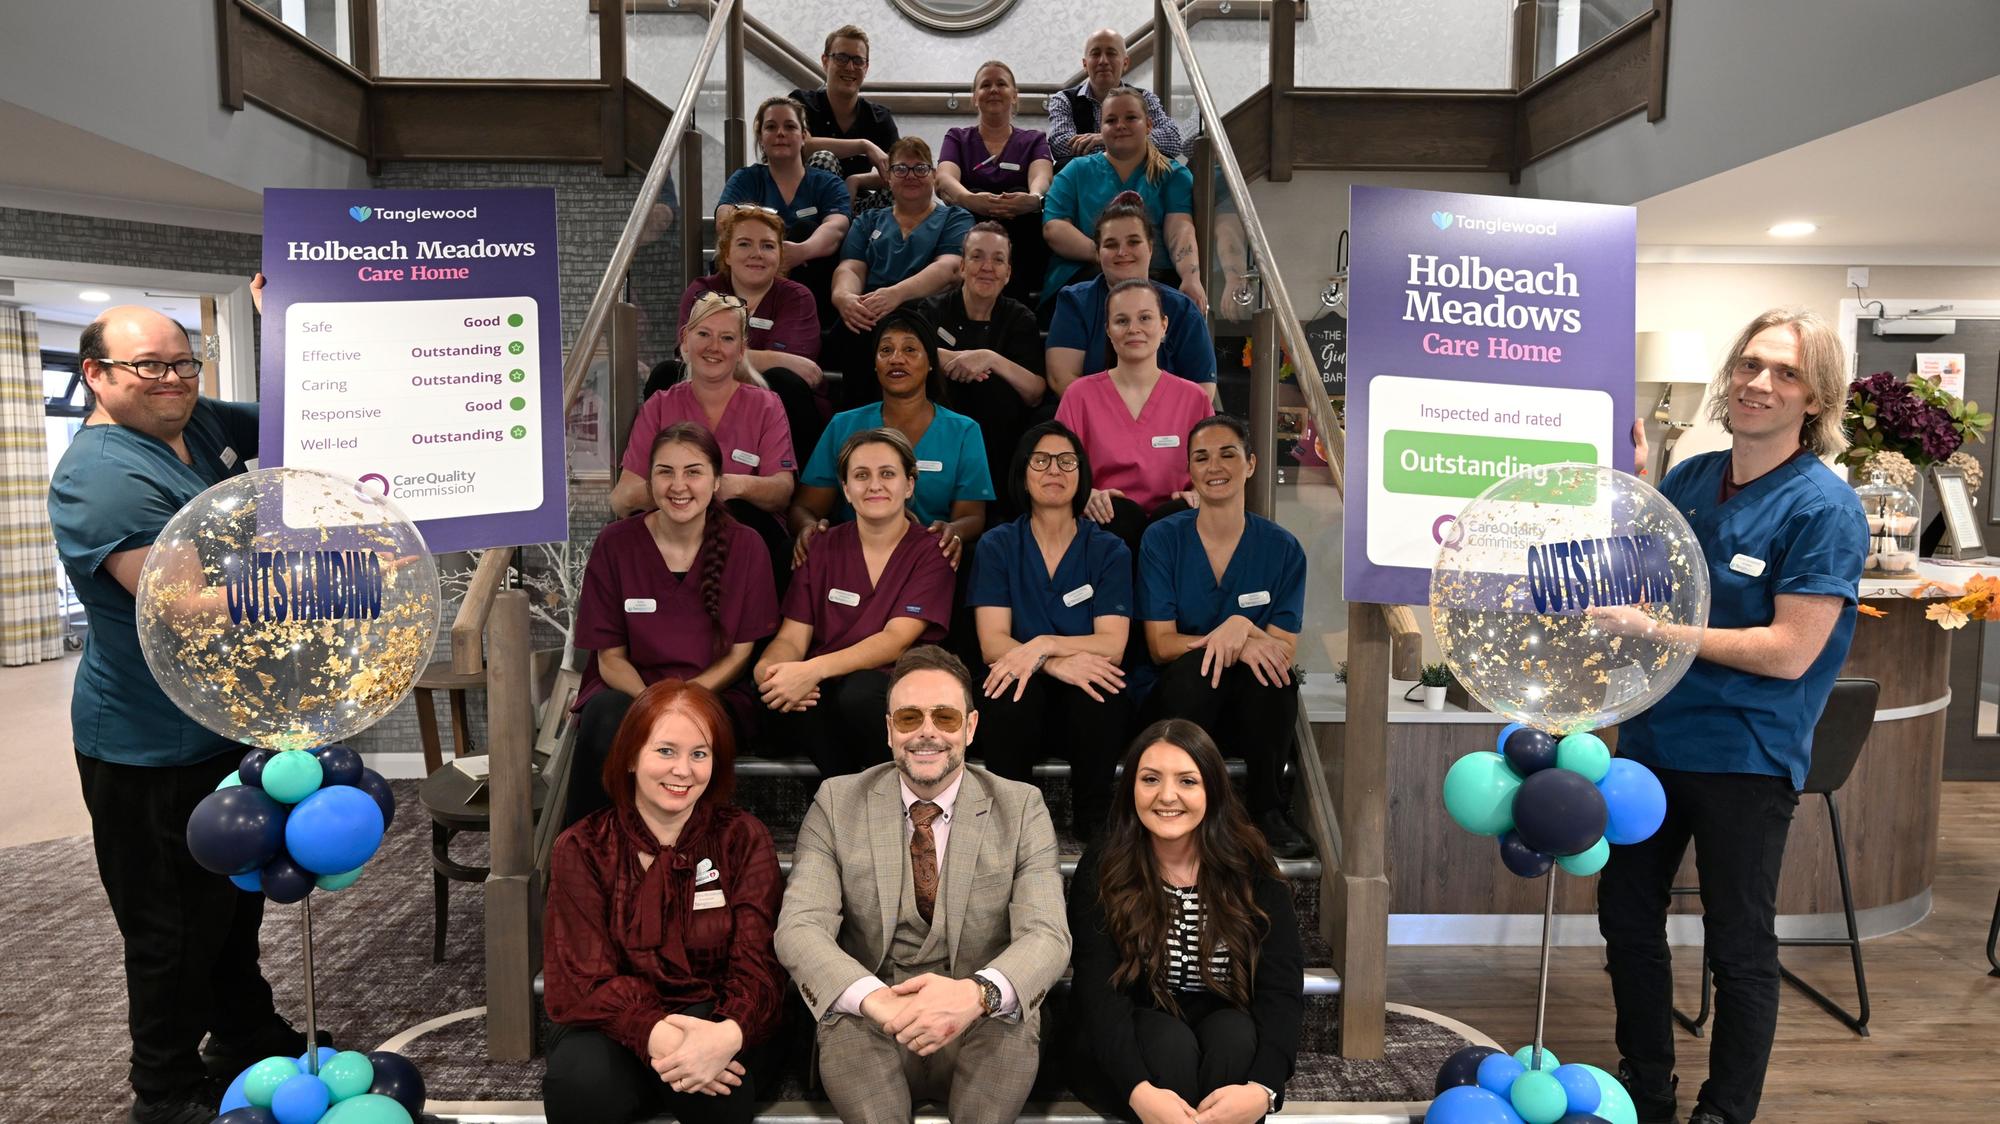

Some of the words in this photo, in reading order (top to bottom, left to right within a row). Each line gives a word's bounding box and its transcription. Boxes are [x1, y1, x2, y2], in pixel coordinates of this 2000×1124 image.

[374, 207, 477, 222] Tanglewood
[1455, 214, 1557, 236] Tanglewood
[288, 241, 408, 262] Holbeach
[416, 239, 536, 260] Meadows
[358, 267, 404, 282] Care
[411, 265, 469, 281] Home
[1407, 254, 1580, 297] Holbeach
[1402, 290, 1582, 333] Meadows
[302, 321, 333, 333] Safe
[464, 315, 500, 327] Good
[1324, 330, 1341, 340] THE
[411, 344, 502, 358] Outstanding
[1423, 333, 1479, 357] Care
[1487, 337, 1562, 363] Home
[302, 350, 361, 362] Effective
[301, 379, 347, 392] Caring
[411, 372, 502, 387] Outstanding
[465, 400, 502, 412] Good
[301, 407, 382, 422] Responsive
[1420, 403, 1489, 425] Inspected
[1494, 409, 1520, 424] and
[1525, 412, 1562, 427] rated
[301, 437, 358, 450] Well-led
[412, 429, 504, 445] Outstanding
[1400, 448, 1549, 486] Outstanding
[393, 482, 475, 499] Commission
